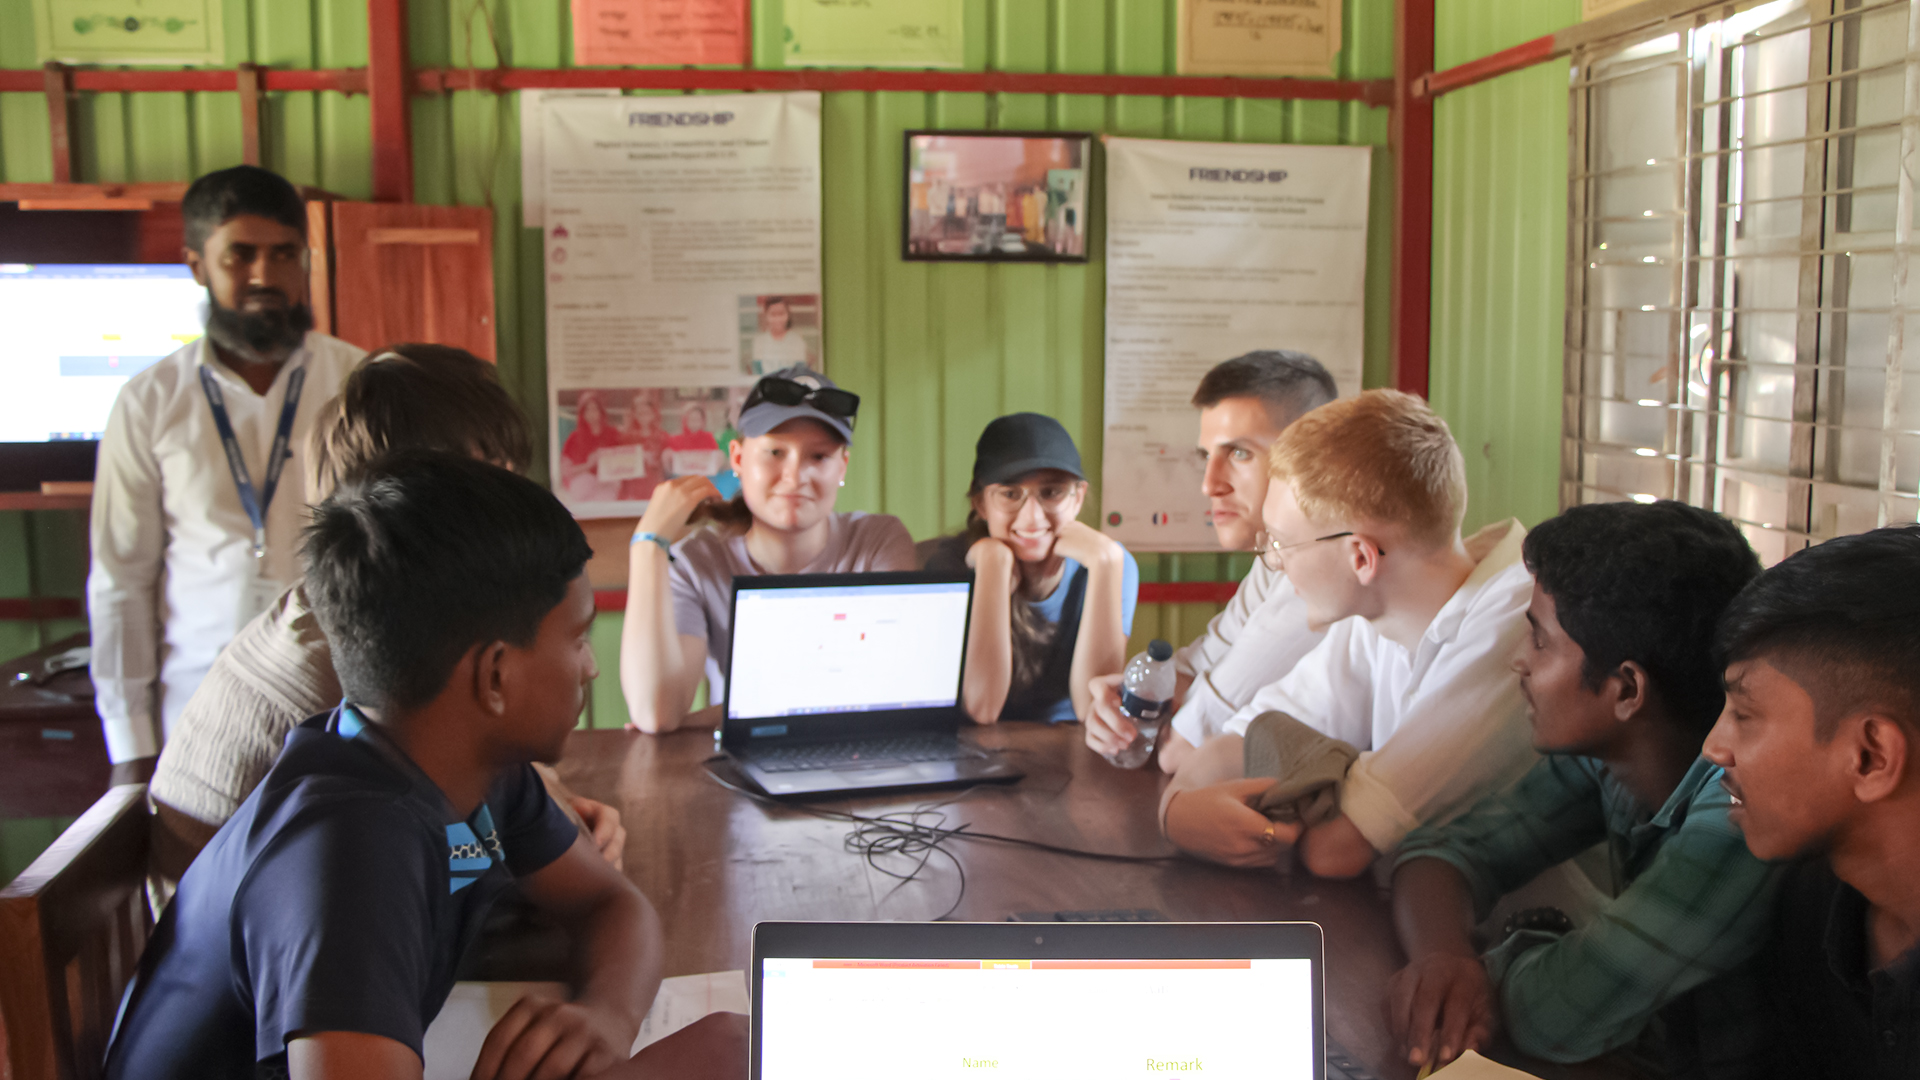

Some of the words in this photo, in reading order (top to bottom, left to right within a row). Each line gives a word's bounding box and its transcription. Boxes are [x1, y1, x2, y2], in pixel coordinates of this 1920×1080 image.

[628, 111, 735, 127] FRIENDSHIP
[1189, 167, 1288, 183] FRIENDSHIP
[962, 1057, 999, 1068] Name
[1146, 1058, 1203, 1072] Remark
